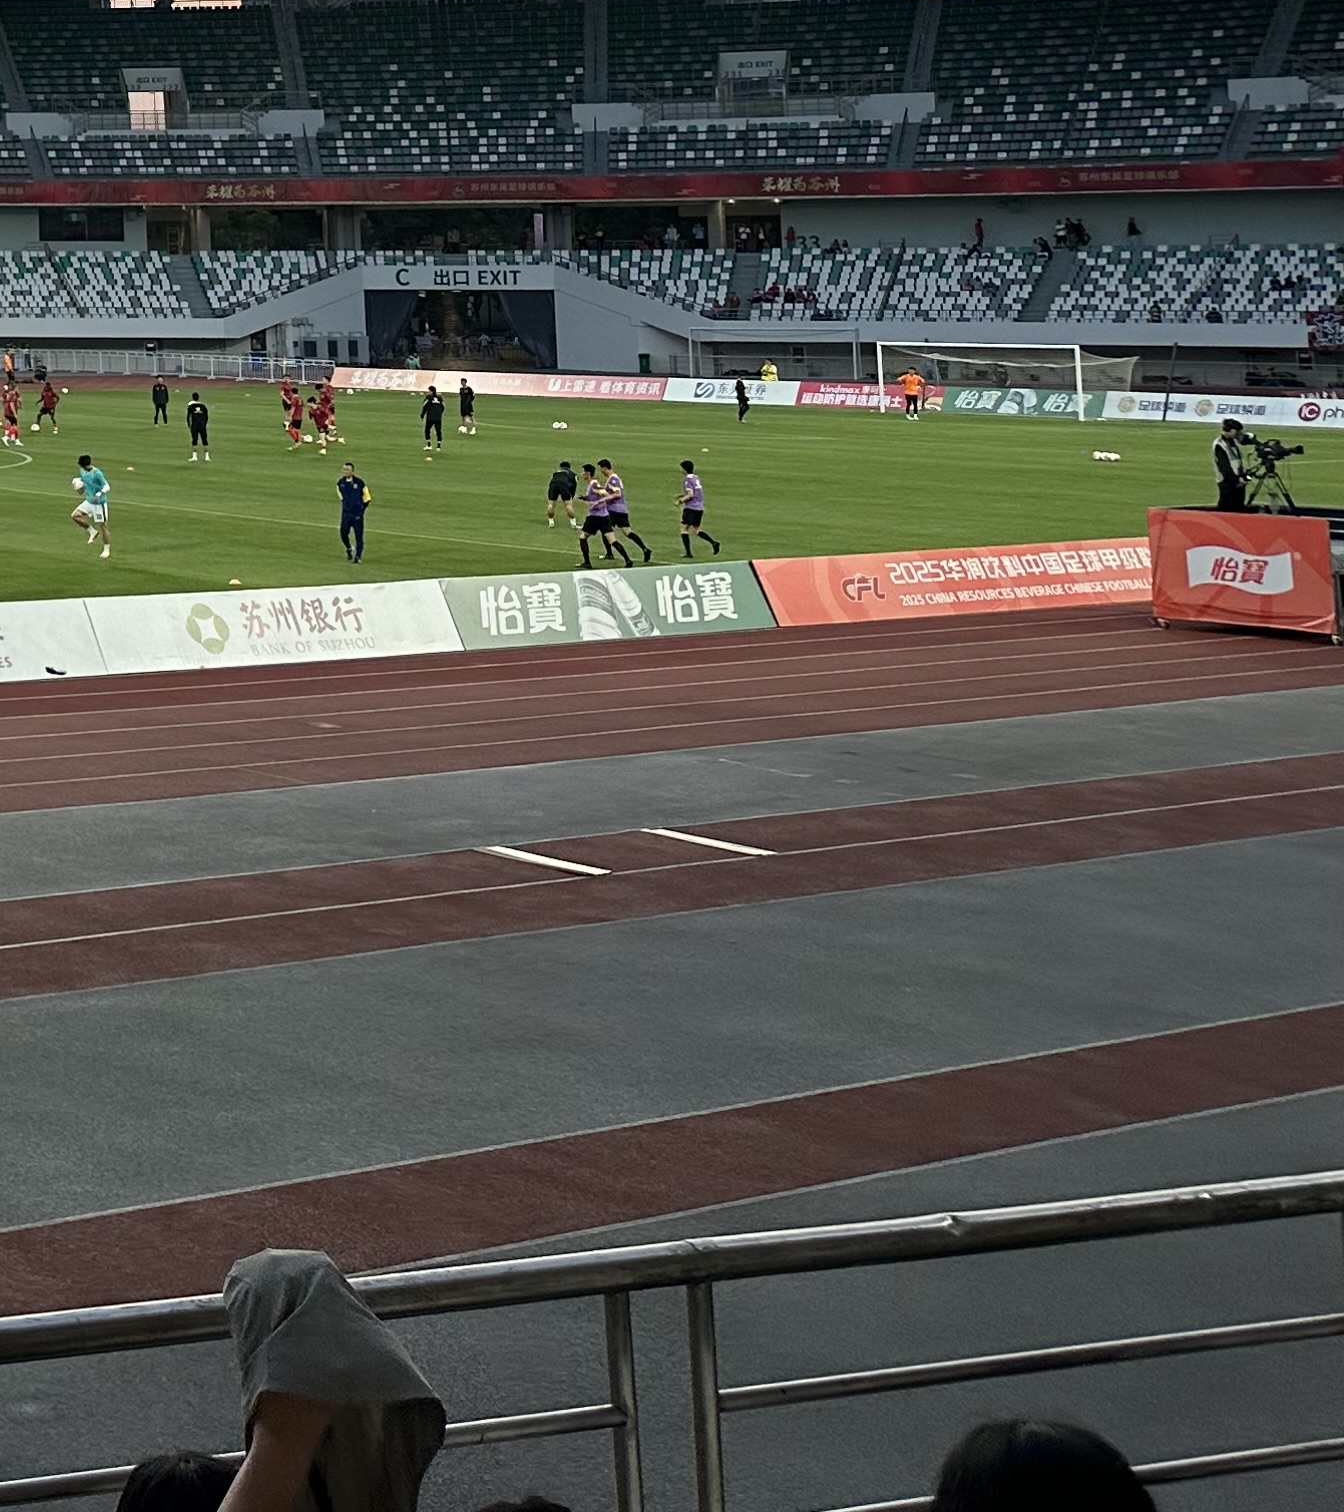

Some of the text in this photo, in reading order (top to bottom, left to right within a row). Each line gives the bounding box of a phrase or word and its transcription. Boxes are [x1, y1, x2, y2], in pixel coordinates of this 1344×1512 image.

[395, 268, 521, 286] C 出口 EXIT
[819, 384, 860, 394] kindmax
[1216, 403, 1267, 416] 足球频道
[841, 573, 886, 603] CFL
[900, 577, 1150, 607] 2025 CHINA RESOURCES BEVERAGE CHINESE FOOTBALL
[479, 571, 739, 635] 怡寶 怡寶
[238, 596, 365, 638] 苏州银行
[250, 637, 376, 656] BANK OF SUZHOU
